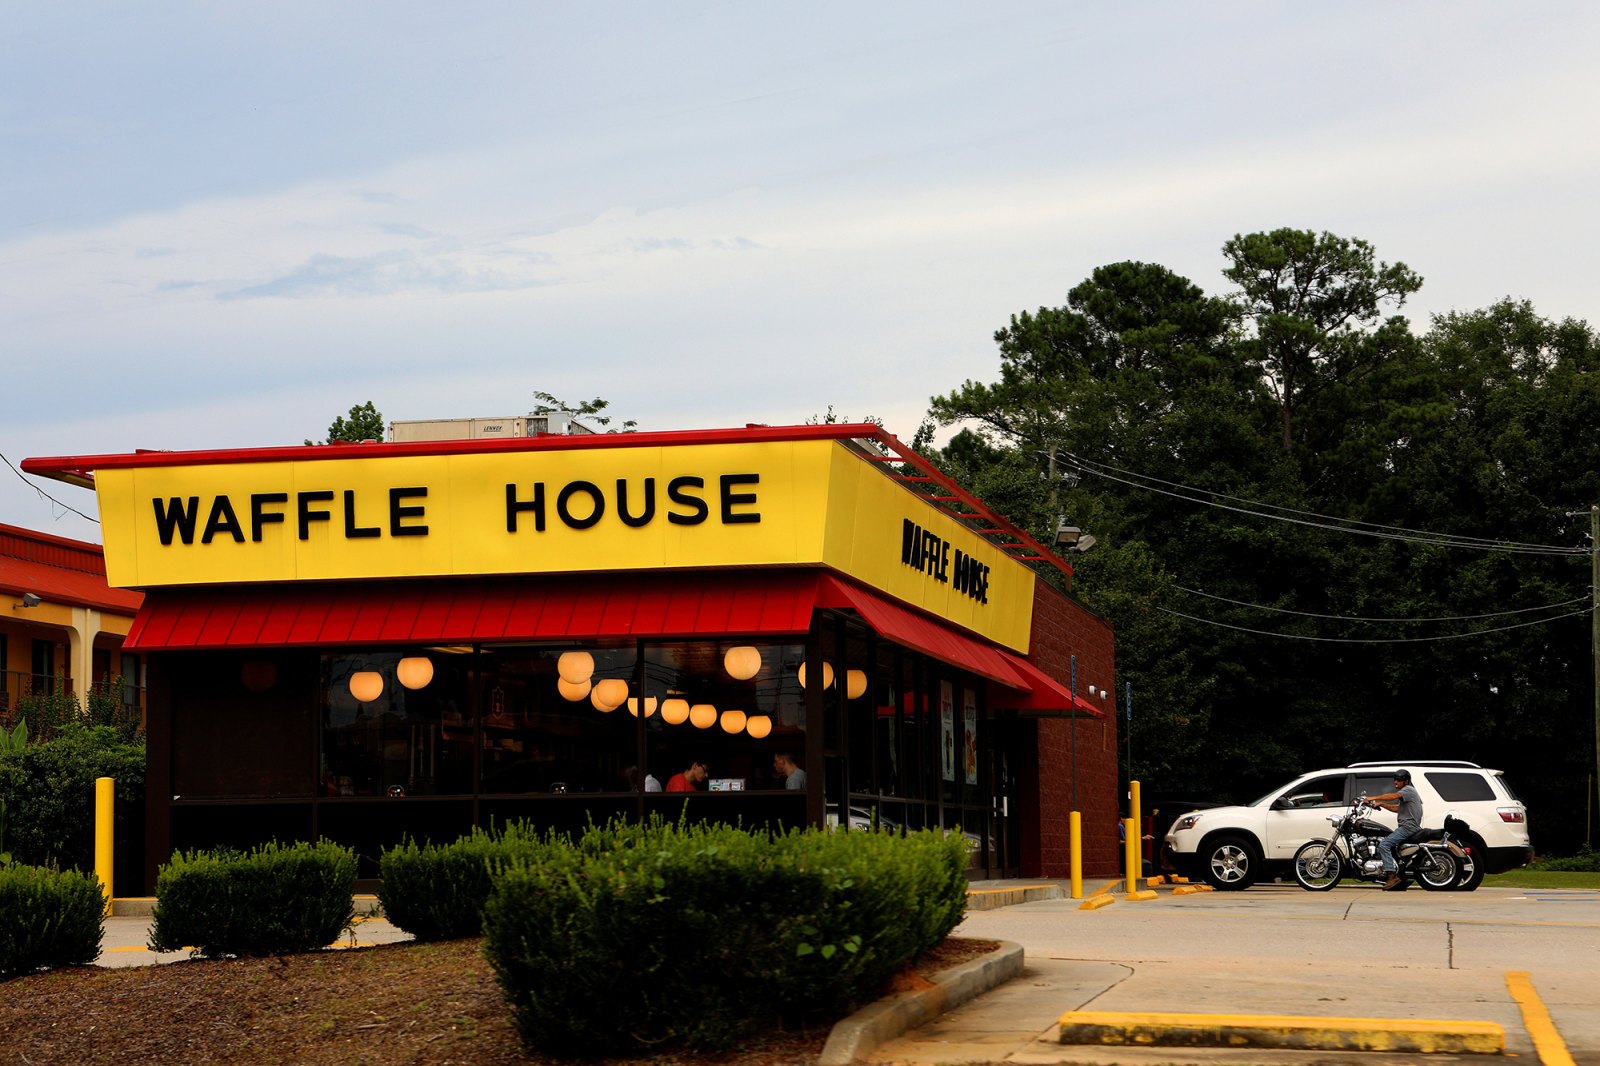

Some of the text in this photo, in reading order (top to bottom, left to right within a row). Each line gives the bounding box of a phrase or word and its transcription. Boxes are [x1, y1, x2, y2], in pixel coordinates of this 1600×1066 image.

[152, 473, 761, 545] WAFFLE HOUSE
[902, 518, 990, 606] WAFFLE HOUSE
